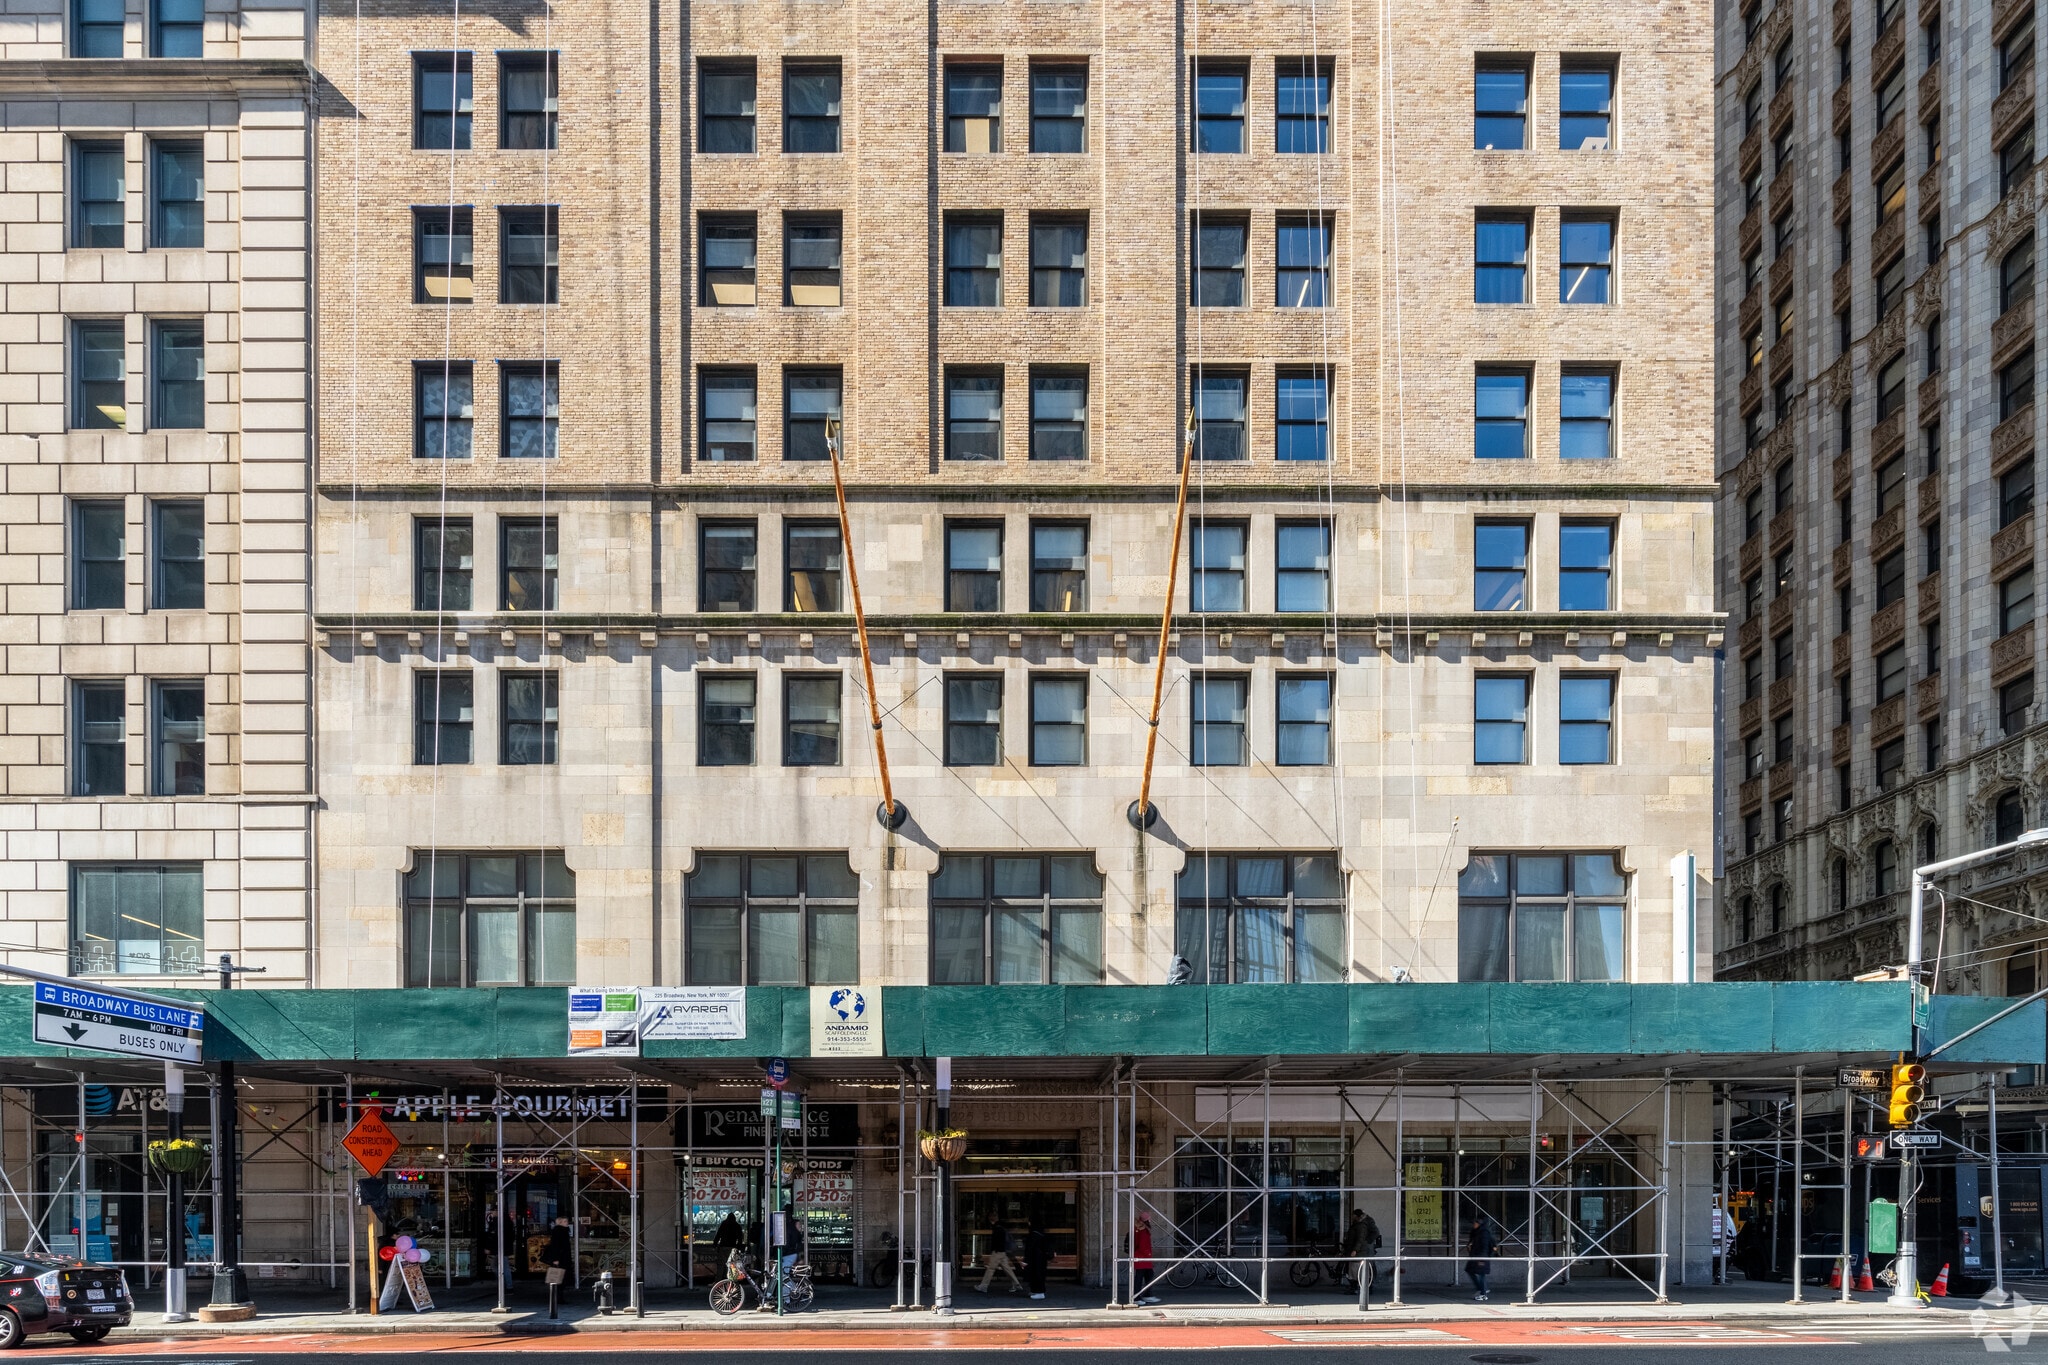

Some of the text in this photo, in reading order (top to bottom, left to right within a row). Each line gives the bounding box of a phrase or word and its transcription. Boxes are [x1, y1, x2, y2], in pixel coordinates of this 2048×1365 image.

[62, 990, 187, 1024] BROADWAY BUS LANE
[64, 1009, 69, 1017] 7
[70, 1010, 83, 1020] AM
[92, 1014, 97, 1022] 6
[99, 1015, 112, 1024] PM
[150, 1023, 166, 1033] MON
[172, 1027, 184, 1036] FRI
[119, 1033, 186, 1054] BUSES ONLY
[1843, 1073, 1880, 1084] Broadway
[393, 1095, 632, 1117] APPLE GOURMET
[983, 1111, 1051, 1122] BUILDING
[362, 1124, 383, 1133] ROAD
[744, 1127, 766, 1137] FINE
[349, 1136, 393, 1146] CONSTRUCTION
[362, 1148, 383, 1157] AHEAD
[706, 1157, 728, 1165] BUY
[731, 1157, 764, 1167] GOLD
[694, 1177, 737, 1188] SALE
[1411, 1175, 1437, 1183] SPACE
[807, 1180, 846, 1189] SALE
[1411, 1195, 1437, 1203] RENT
[1917, 1196, 1942, 1204] Services
[1416, 1207, 1432, 1215] (212)
[1982, 1202, 1993, 1214] up
